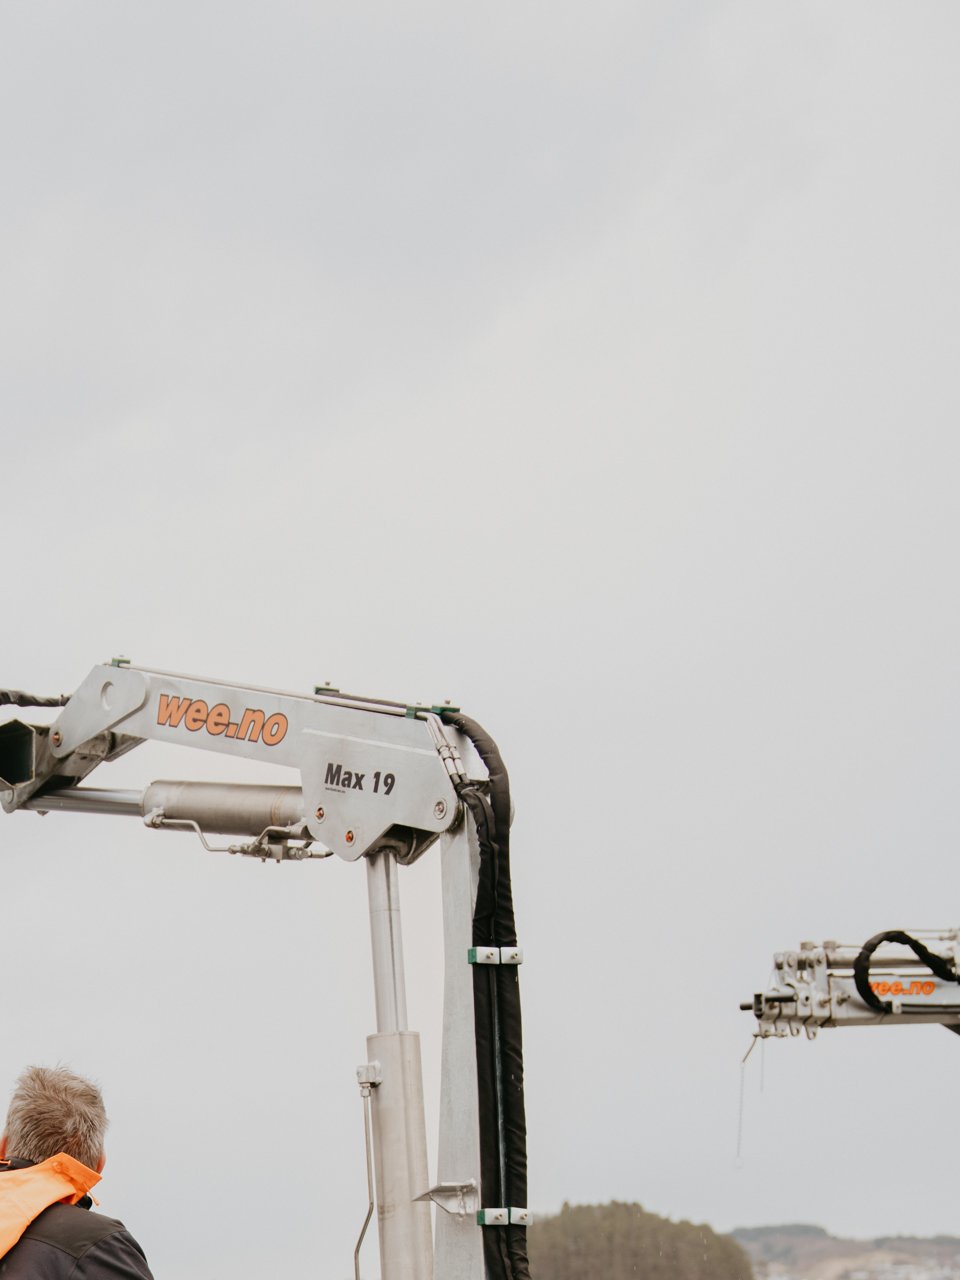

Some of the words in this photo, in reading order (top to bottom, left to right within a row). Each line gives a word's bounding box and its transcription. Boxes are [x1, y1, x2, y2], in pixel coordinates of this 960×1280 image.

[157, 693, 289, 747] wee.no
[324, 762, 366, 791] Max
[372, 771, 396, 796] 19
